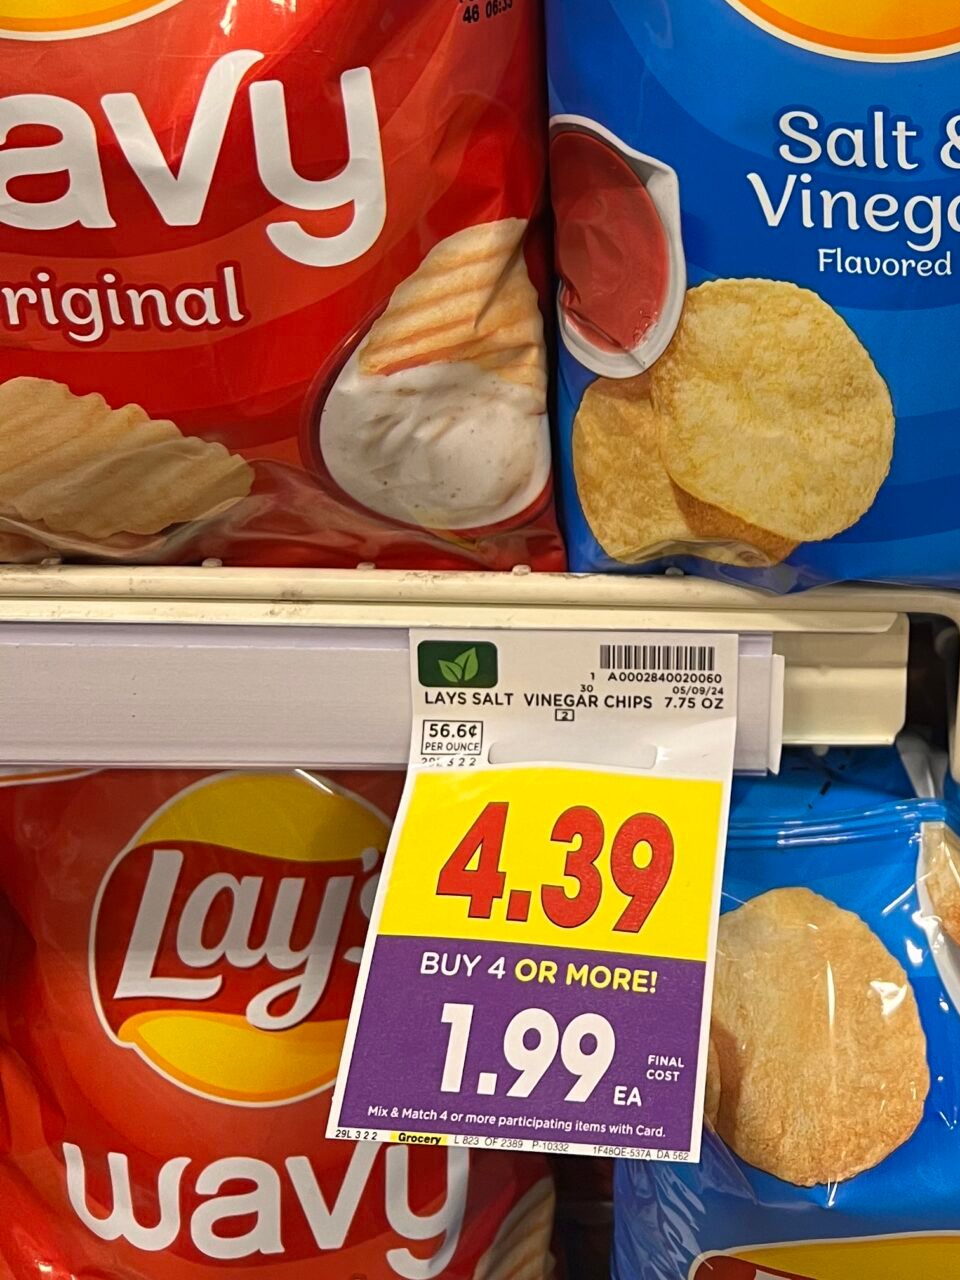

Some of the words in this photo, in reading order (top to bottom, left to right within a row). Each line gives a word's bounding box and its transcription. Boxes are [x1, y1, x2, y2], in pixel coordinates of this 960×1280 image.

[463, 5, 479, 24] 46
[779, 110, 919, 170] Salt
[818, 249, 954, 278] Flavored
[0, 266, 245, 343] riginal
[608, 672, 722, 683] A0002840020060
[424, 692, 467, 706] LAYS
[472, 692, 514, 706] SALT
[524, 694, 598, 708] VINEGAR
[604, 695, 652, 709] CHIPS
[664, 696, 696, 709] 7.75
[701, 697, 724, 709] OZ
[580, 685, 593, 693] 30
[673, 686, 724, 695] 05/09/24
[561, 711, 568, 719] 2
[429, 723, 478, 738] 56.6¢
[425, 741, 443, 750] PER
[446, 742, 480, 751] OUNCE
[458, 757, 465, 766] 2
[469, 757, 476, 766] 2
[436, 801, 675, 933] 4.39
[114, 848, 380, 1029] Lay'
[420, 951, 481, 978] BUY
[488, 956, 506, 978] 4
[514, 959, 557, 984] OR
[565, 964, 658, 993] MORE!
[440, 1003, 616, 1103] 1.99
[647, 1054, 685, 1068] FINAL
[646, 1068, 680, 1082] COST
[613, 1086, 642, 1107] EA
[367, 1105, 388, 1118] Mix
[390, 1107, 399, 1118] &
[401, 1107, 438, 1122] Match
[439, 1110, 448, 1121] 4
[450, 1113, 463, 1122] or
[465, 1114, 497, 1125] more
[499, 1114, 573, 1132] participating
[575, 1119, 606, 1133] items
[608, 1121, 633, 1135] with
[635, 1124, 666, 1138] Card.
[335, 1128, 353, 1139] 29L
[354, 1130, 361, 1140] 3
[362, 1131, 369, 1140] 2
[371, 1132, 378, 1141] 2
[398, 1132, 442, 1145] Grocery
[454, 1136, 459, 1144] L
[462, 1136, 479, 1146] 823
[484, 1137, 499, 1147] OF
[501, 1138, 524, 1149] 2389
[532, 1140, 569, 1152] P-10332
[656, 1150, 671, 1159] DA
[672, 1151, 689, 1160] 562
[62, 1140, 470, 1279] wavy
